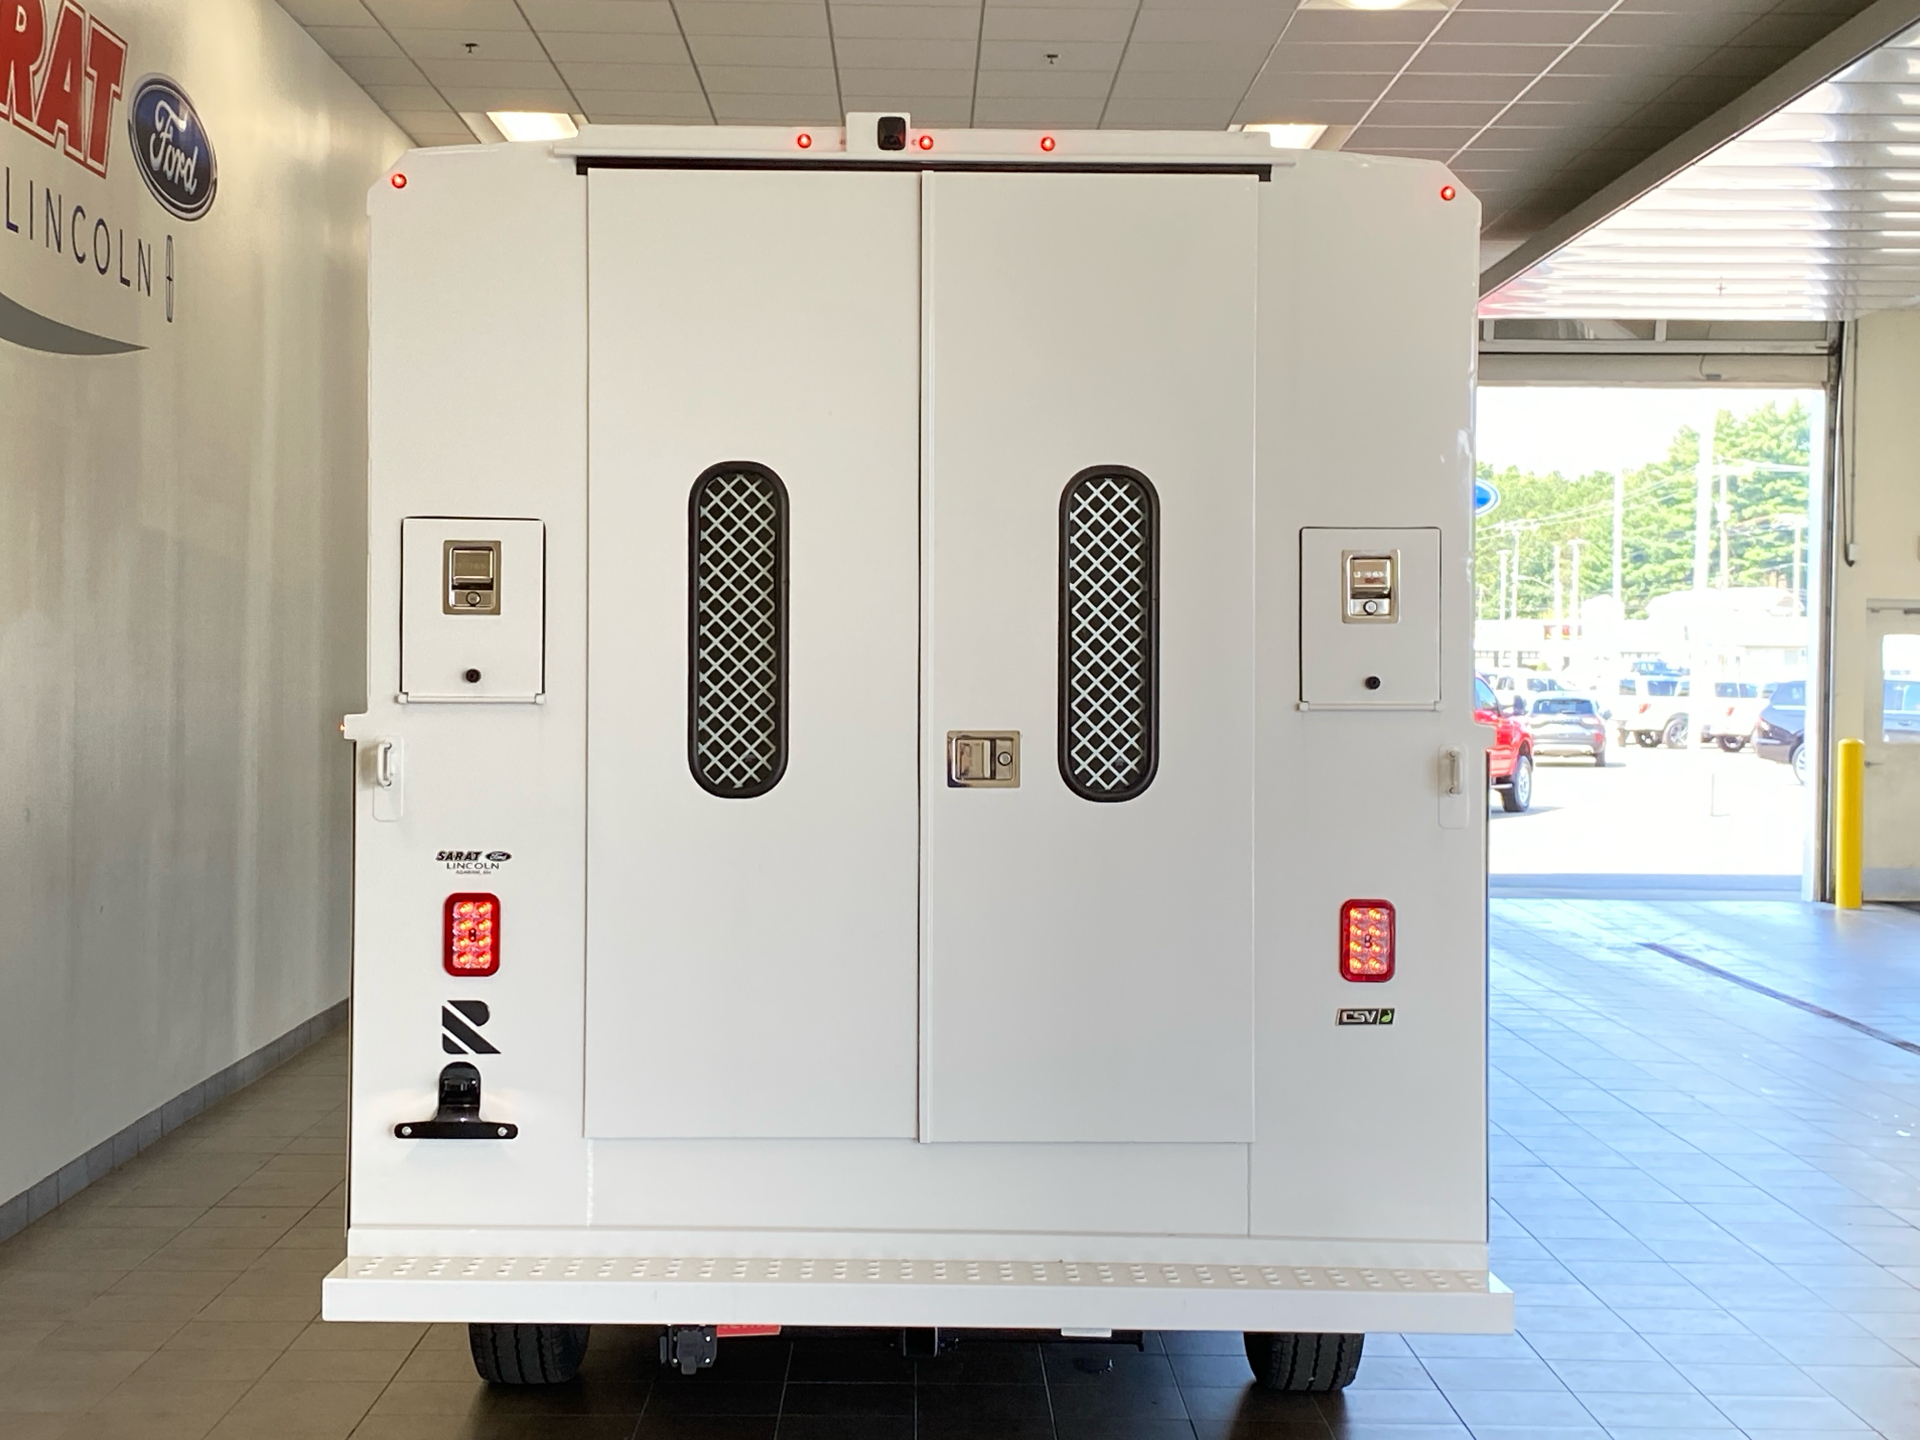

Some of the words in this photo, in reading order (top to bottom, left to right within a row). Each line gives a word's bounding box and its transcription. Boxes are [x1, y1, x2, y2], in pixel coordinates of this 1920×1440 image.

[149, 99, 200, 196] Ford
[6, 166, 151, 298] LINCOLN
[436, 850, 483, 861] SARAT
[446, 862, 500, 870] LINCOLN
[1341, 1010, 1377, 1023] CSV
